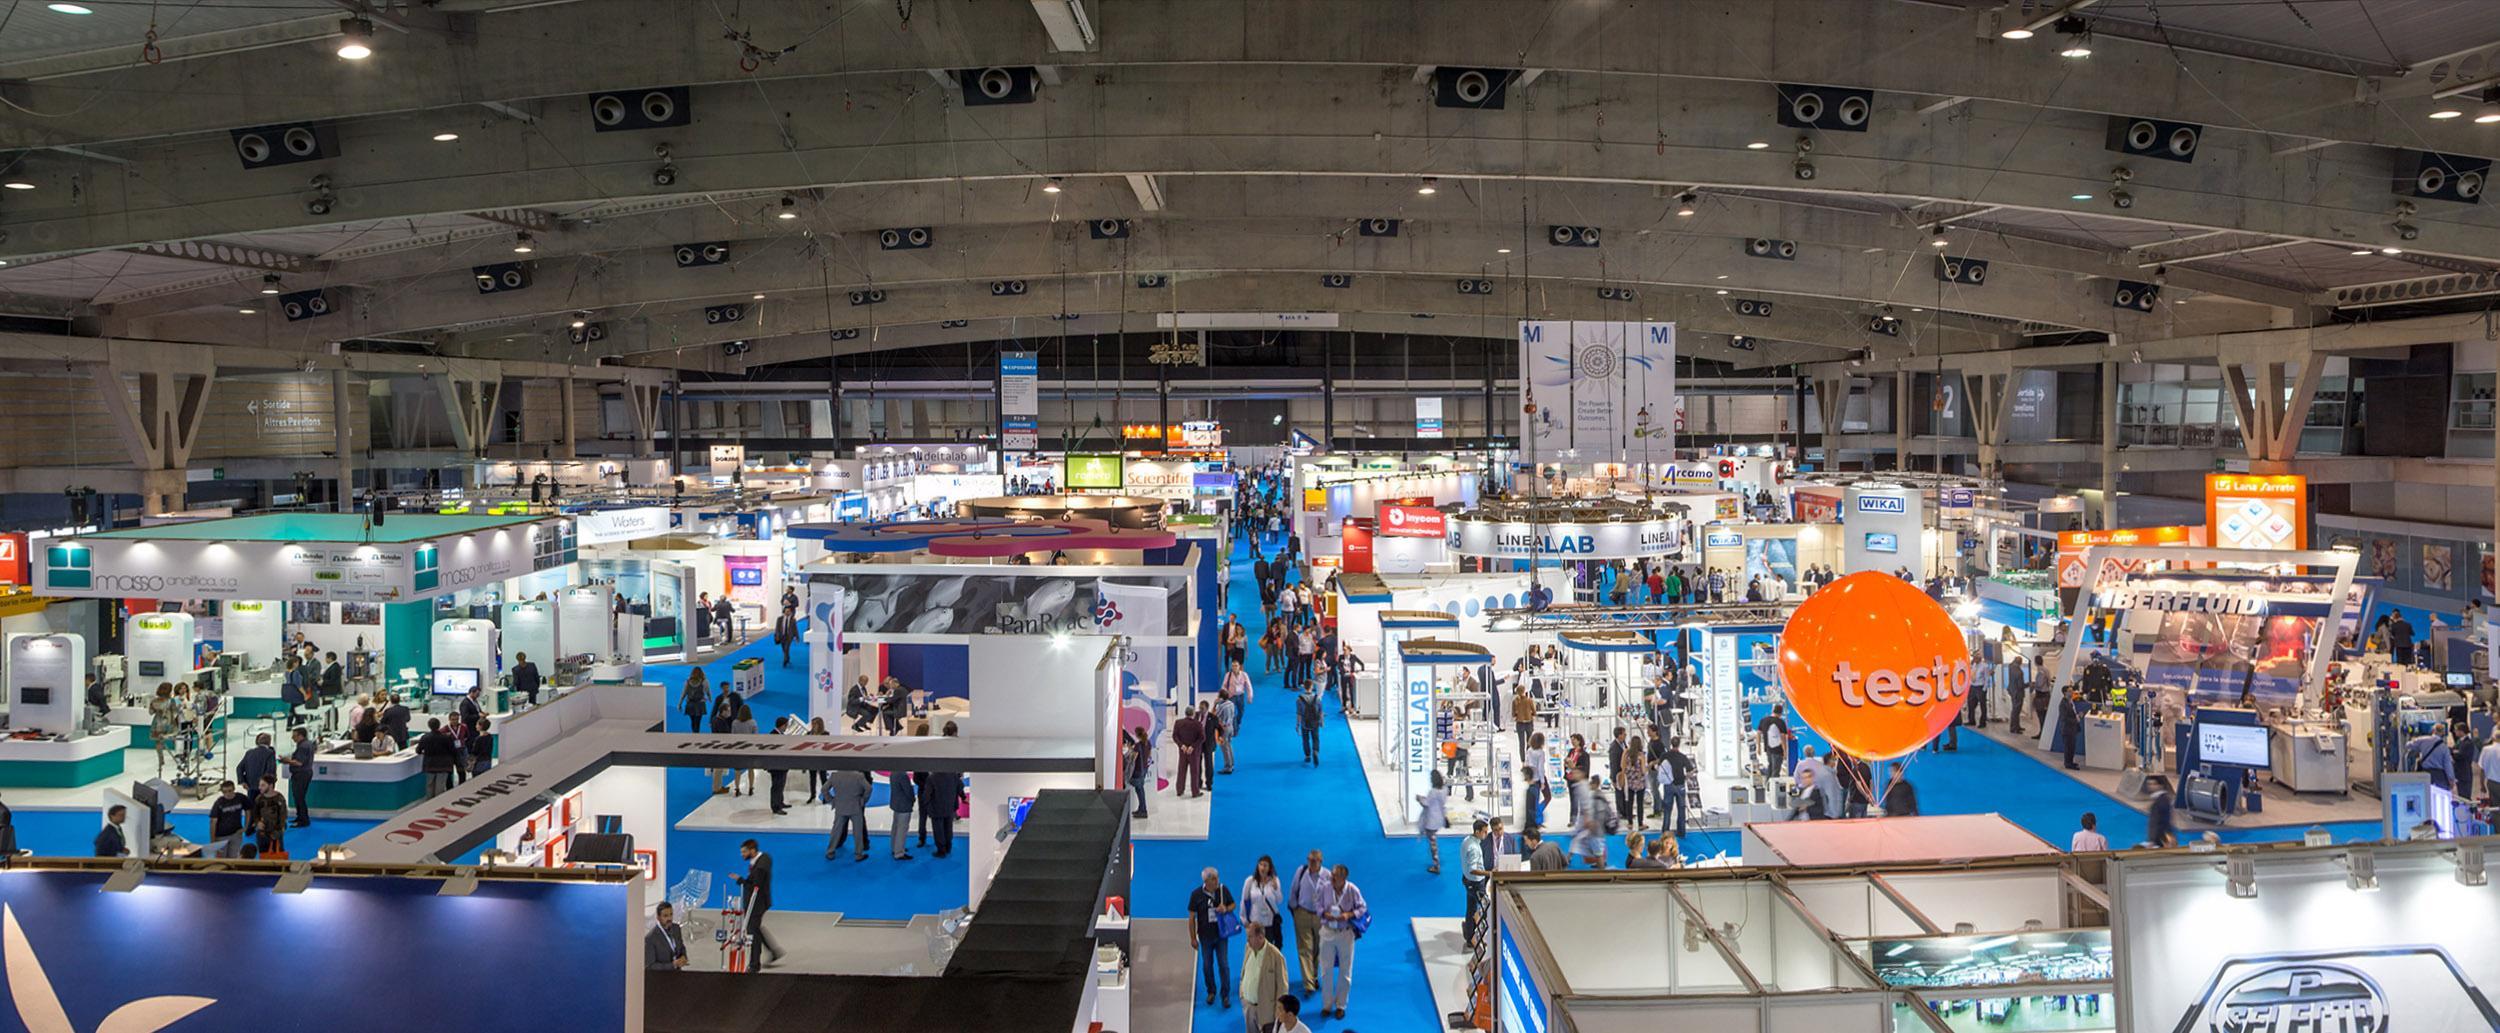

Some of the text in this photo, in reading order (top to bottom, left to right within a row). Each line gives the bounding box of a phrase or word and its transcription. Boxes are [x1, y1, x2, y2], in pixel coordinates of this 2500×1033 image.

[1651, 326, 1668, 344] M
[1942, 385, 1954, 418] 2
[924, 450, 968, 461] deltalab
[864, 460, 915, 481] METTLER TOLEDO
[1661, 466, 1713, 486] Arcamo
[1128, 472, 1191, 483] Scientific
[2234, 482, 2258, 491] Lana
[1861, 499, 1897, 510] WIKA
[611, 514, 645, 528] Waters
[1711, 534, 1737, 544] WIKA
[2088, 534, 2108, 543] Lana
[95, 575, 164, 591] masso
[1832, 655, 1969, 708] testo
[2162, 672, 2192, 681] Soluciones
[677, 739, 889, 752] vidra FOC
[384, 772, 533, 846] vidra FOC
